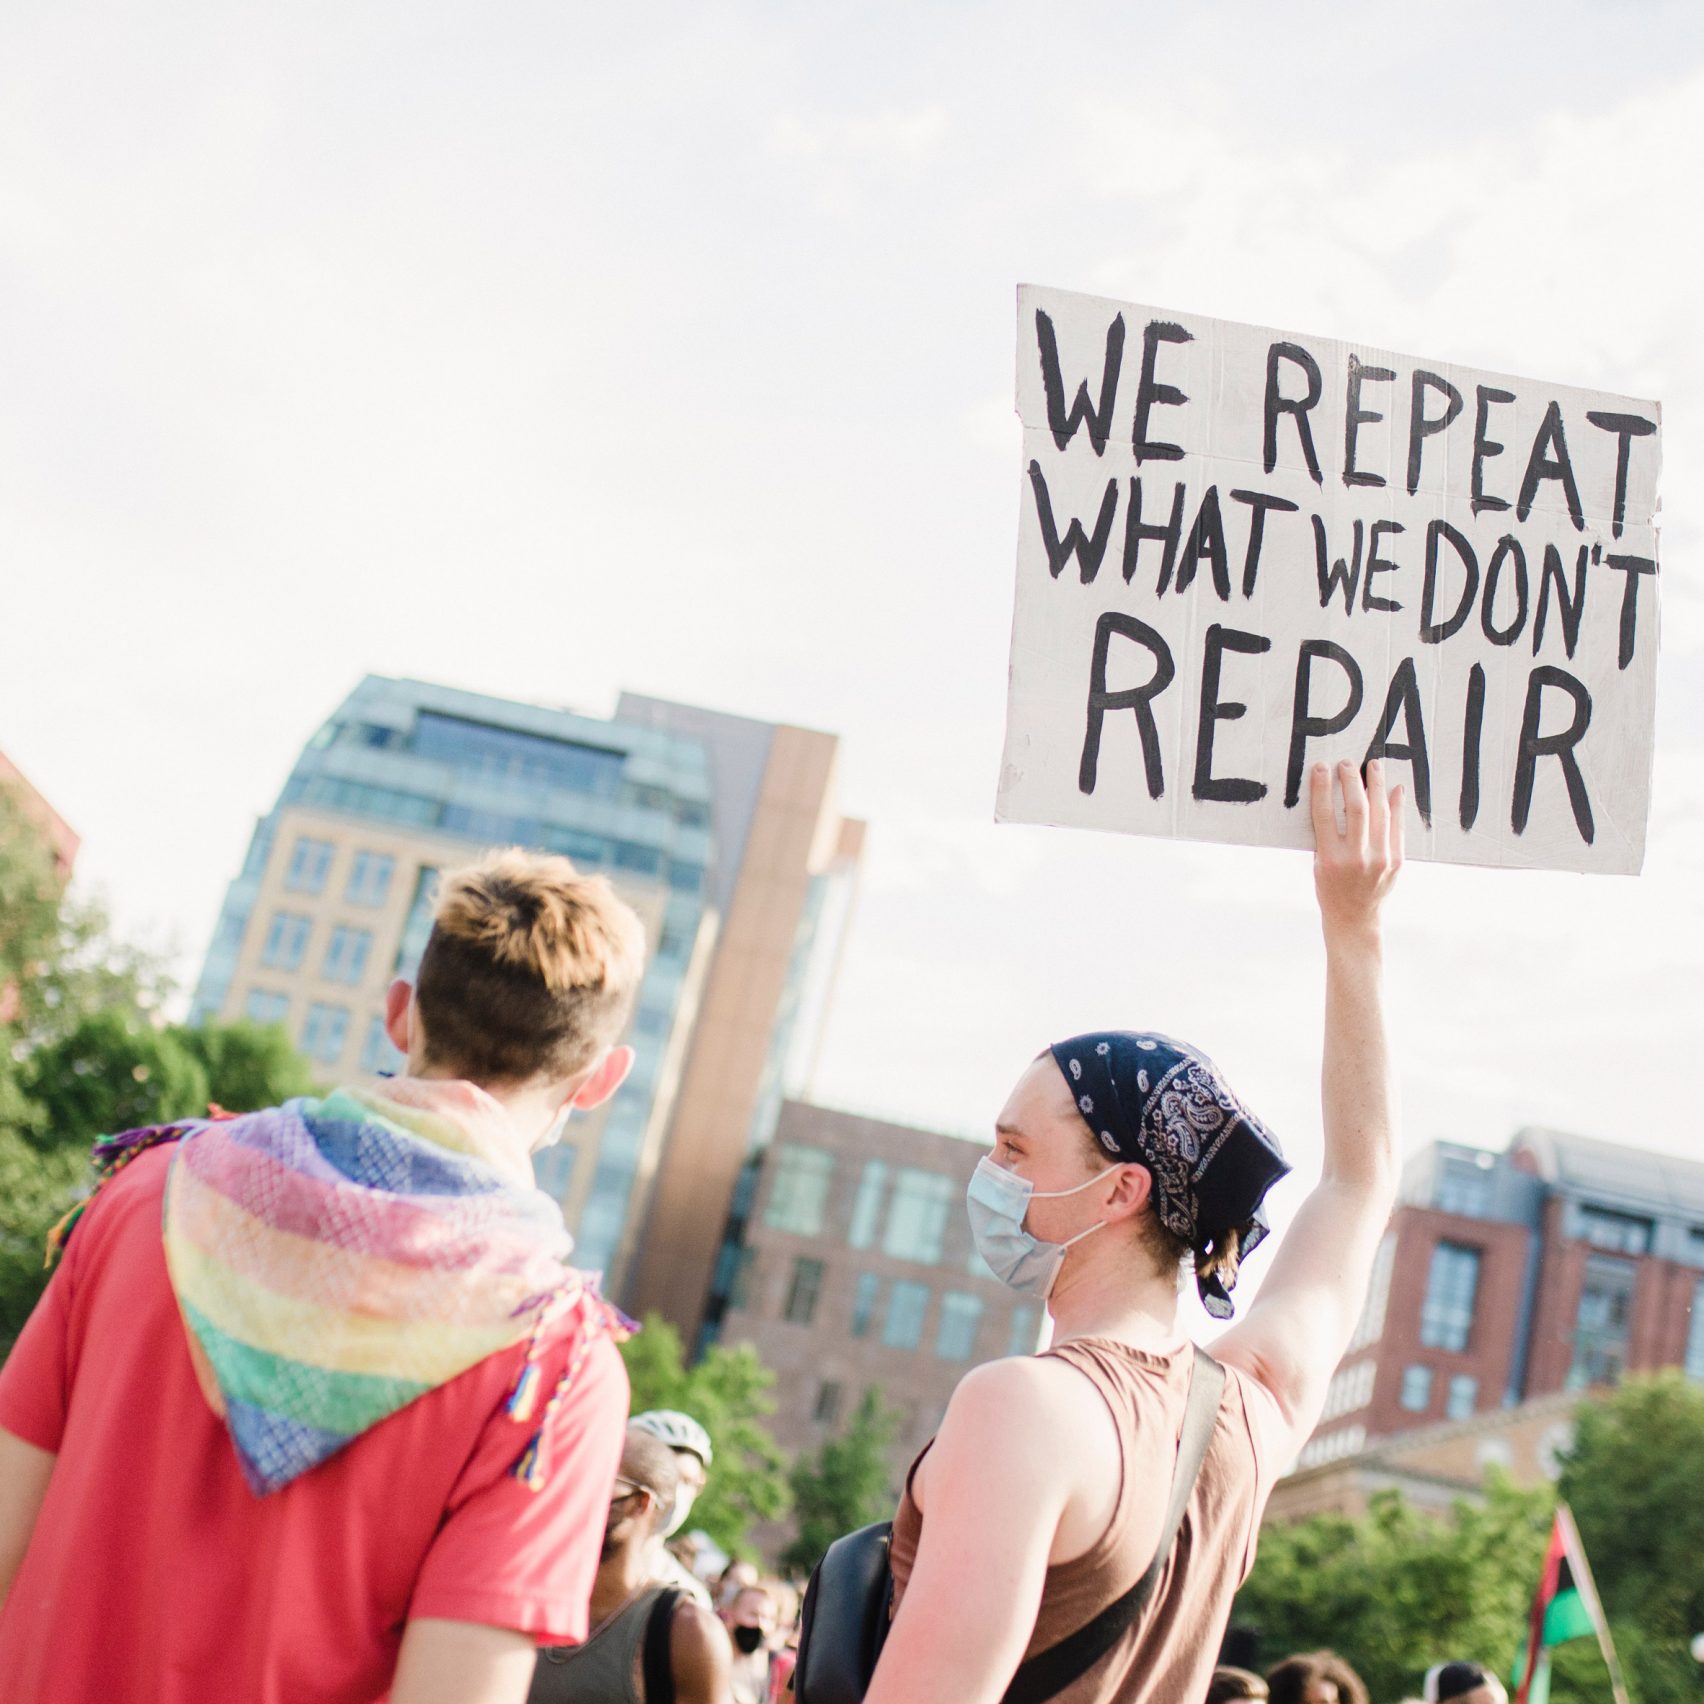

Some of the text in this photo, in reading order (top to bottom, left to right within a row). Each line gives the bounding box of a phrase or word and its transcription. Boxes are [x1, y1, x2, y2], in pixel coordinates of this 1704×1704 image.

[1035, 307, 1657, 539] WE REPEAT
[1028, 459, 1657, 670] WHAT WE DON'T
[1078, 610, 1596, 846] REPAIR
